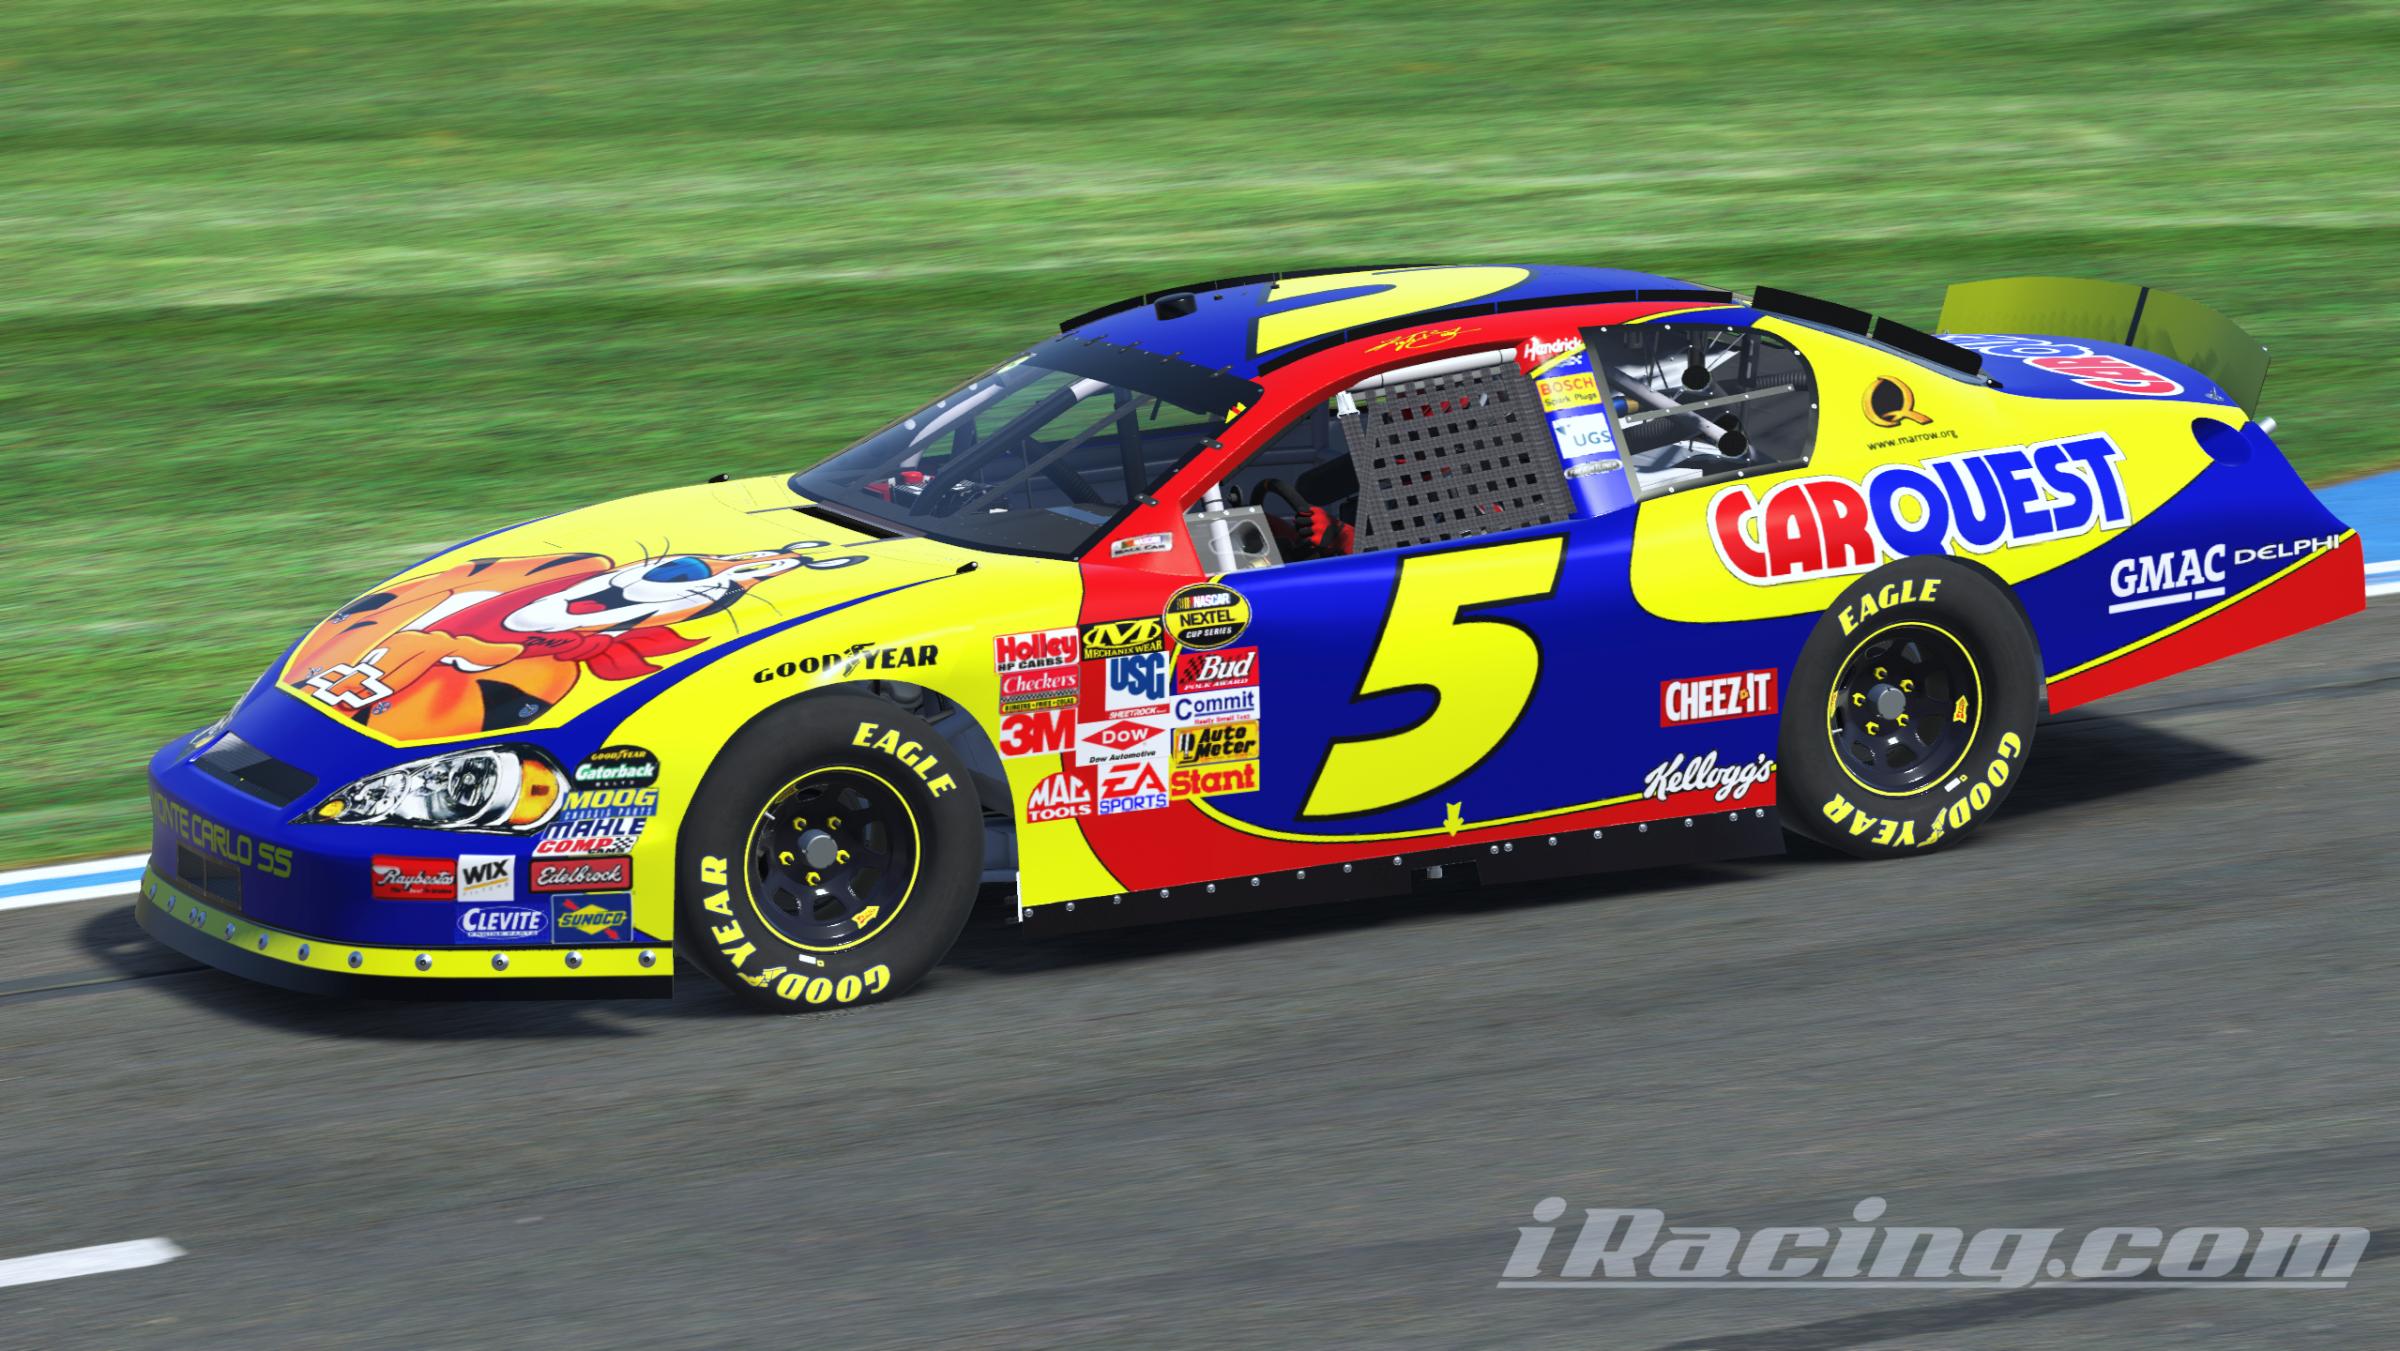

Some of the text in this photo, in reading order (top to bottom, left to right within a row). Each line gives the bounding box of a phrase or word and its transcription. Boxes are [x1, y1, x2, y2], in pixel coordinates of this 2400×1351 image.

[1524, 336, 1583, 361] Hendrick
[1540, 377, 1595, 396] BOSCH
[1574, 391, 1597, 401] Plugs
[1862, 375, 1934, 428] Q
[1573, 430, 1612, 447] UGS
[1867, 429, 1959, 451] www.marrow.org
[1714, 435, 2126, 579] CARQUEST
[2234, 534, 2339, 565] DELPHI
[2110, 544, 2226, 598] GMAC
[1193, 593, 1231, 607] NASCAR
[1838, 578, 1942, 637] EAGLE
[1180, 609, 1236, 627] NEXTEL
[1186, 626, 1232, 639] CUP SERIES
[996, 633, 1077, 664] Holley
[1084, 640, 1163, 660] MECHANIX WEAR
[998, 656, 1063, 672] HP CARBS
[1196, 652, 1256, 682] Bud
[1003, 672, 1077, 693] Checkers
[1110, 652, 1165, 701] USG
[1295, 532, 1570, 822] 5
[1109, 706, 1156, 719] SHEETROCK
[1175, 691, 1255, 721] Commit
[1000, 711, 1075, 756] 3M
[1200, 726, 1247, 744] Auto
[851, 722, 957, 798] EAGLE
[1109, 751, 1156, 761] Automotive
[1196, 740, 1256, 758] Meter
[575, 763, 655, 781] Gatorback
[1101, 762, 1167, 799] EA
[1171, 763, 1255, 797] Stant
[1644, 750, 1774, 802] Kellogg's
[562, 789, 658, 811] MOOG
[1029, 774, 1091, 809] MAC
[564, 807, 652, 820] CHASSIS PARTS
[1029, 804, 1091, 821] TOOLS
[1099, 794, 1168, 814] SPORTS
[154, 791, 293, 878] ONTE CARLO SS
[536, 838, 614, 854] COMP
[377, 868, 455, 889] Raybestos
[463, 859, 509, 885] WIX
[537, 865, 623, 886] Edelbrock
[463, 908, 542, 932] CLEVITE
[560, 912, 626, 926] SUNOCO
